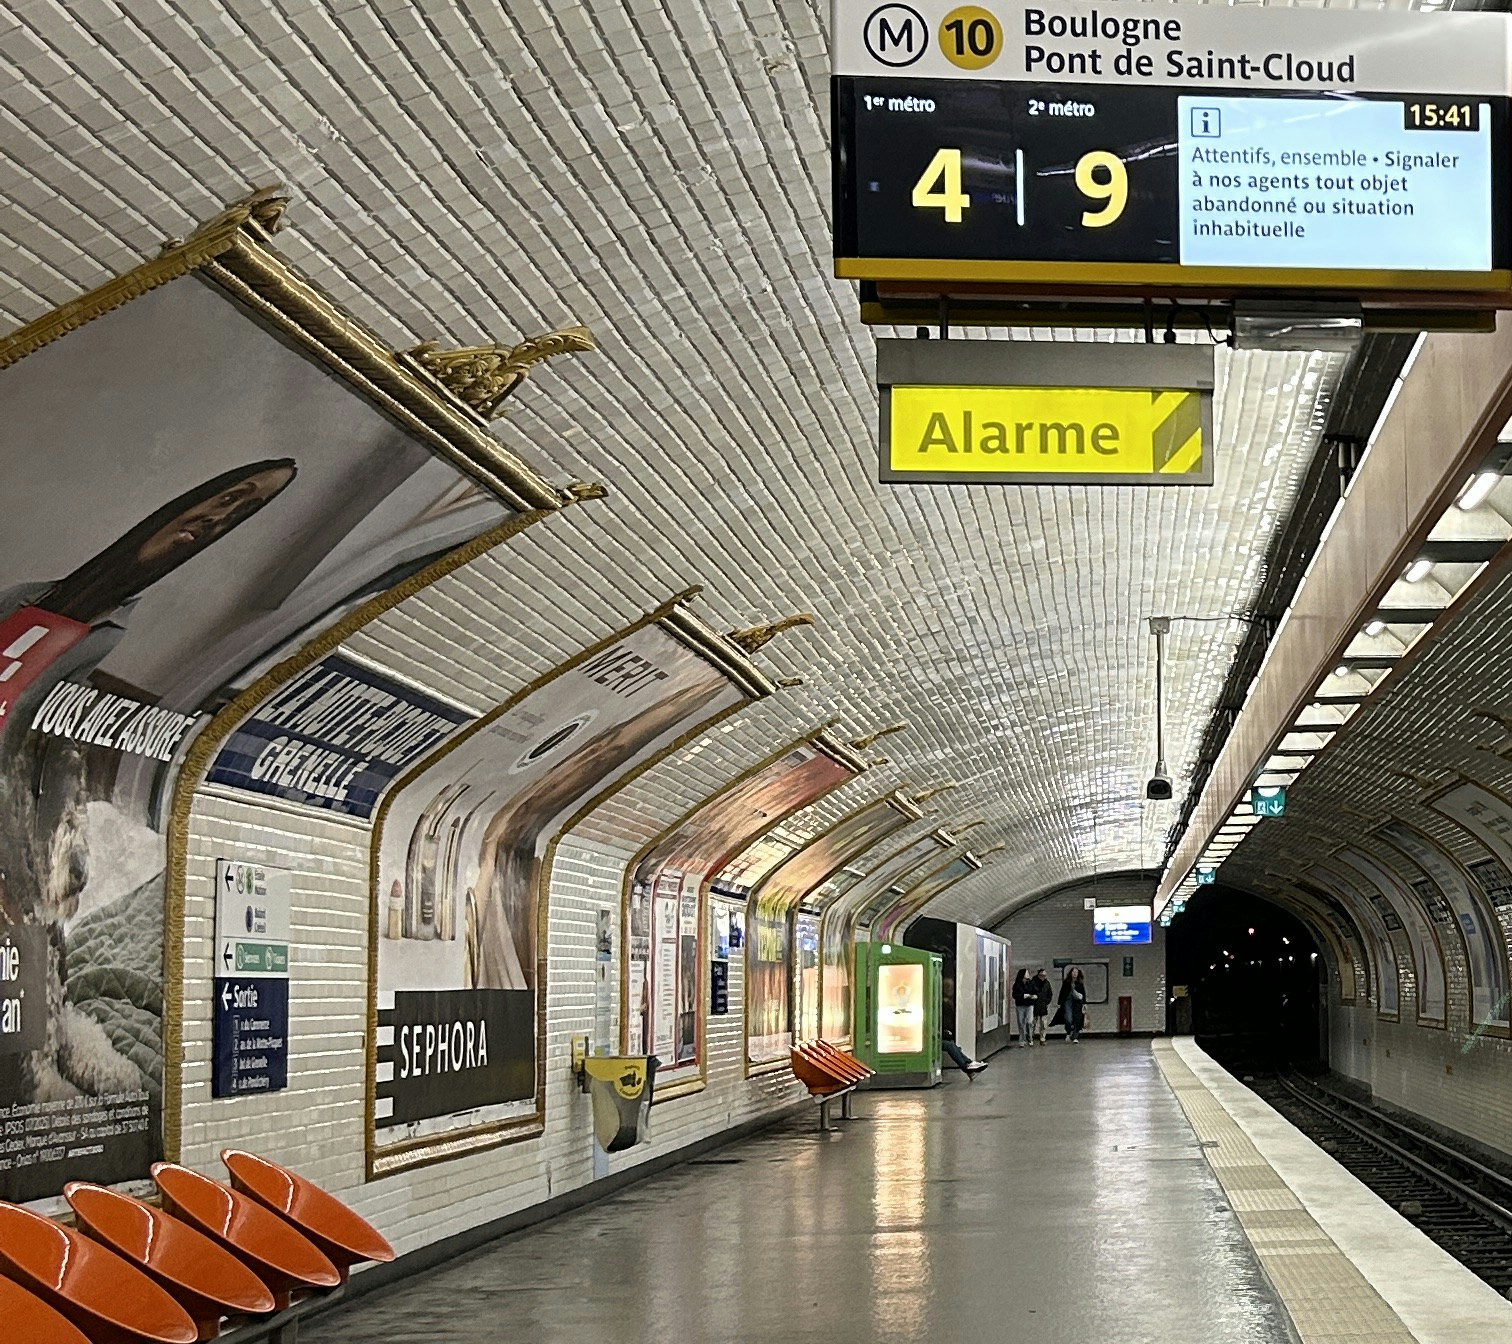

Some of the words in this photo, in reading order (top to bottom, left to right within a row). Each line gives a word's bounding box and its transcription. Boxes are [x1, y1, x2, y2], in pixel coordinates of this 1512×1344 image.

[944, 18, 995, 56] 10
[1025, 9, 1182, 47] Boulogne
[1025, 45, 1103, 76] Pont
[1114, 48, 1154, 77] de
[1166, 50, 1355, 84] Saint-Cloud
[863, 95, 886, 111] 1er
[888, 96, 936, 113] métro
[1028, 99, 1045, 115] 2e
[1048, 99, 1095, 117] métro
[1409, 104, 1472, 128] 15:41
[1191, 146, 1277, 168] Attentifs,
[1280, 149, 1368, 168] ensemble
[1384, 150, 1460, 171] Signaler
[912, 148, 970, 223] 4
[1074, 150, 1129, 228] 9
[1192, 171, 1203, 188] à
[1209, 174, 1242, 189] nos
[1248, 174, 1310, 192] agents
[1316, 175, 1354, 191] tout
[1360, 175, 1408, 196] objet
[1192, 197, 1297, 214] abandonné
[1304, 200, 1326, 215] ou
[1332, 199, 1415, 217] situation
[1193, 220, 1306, 239] inhabituelle
[917, 410, 1121, 456] Alarme
[577, 645, 669, 698] MERIT
[252, 665, 339, 726] LA
[31, 680, 99, 738] VOUS
[75, 693, 141, 747] AVEZ
[114, 709, 203, 762] ASSURÉ
[283, 676, 458, 765] MOTTE-PICQUET
[251, 736, 370, 801] GRENELLE
[233, 984, 258, 1008] Sortie
[400, 1020, 488, 1079] SEPHORA
